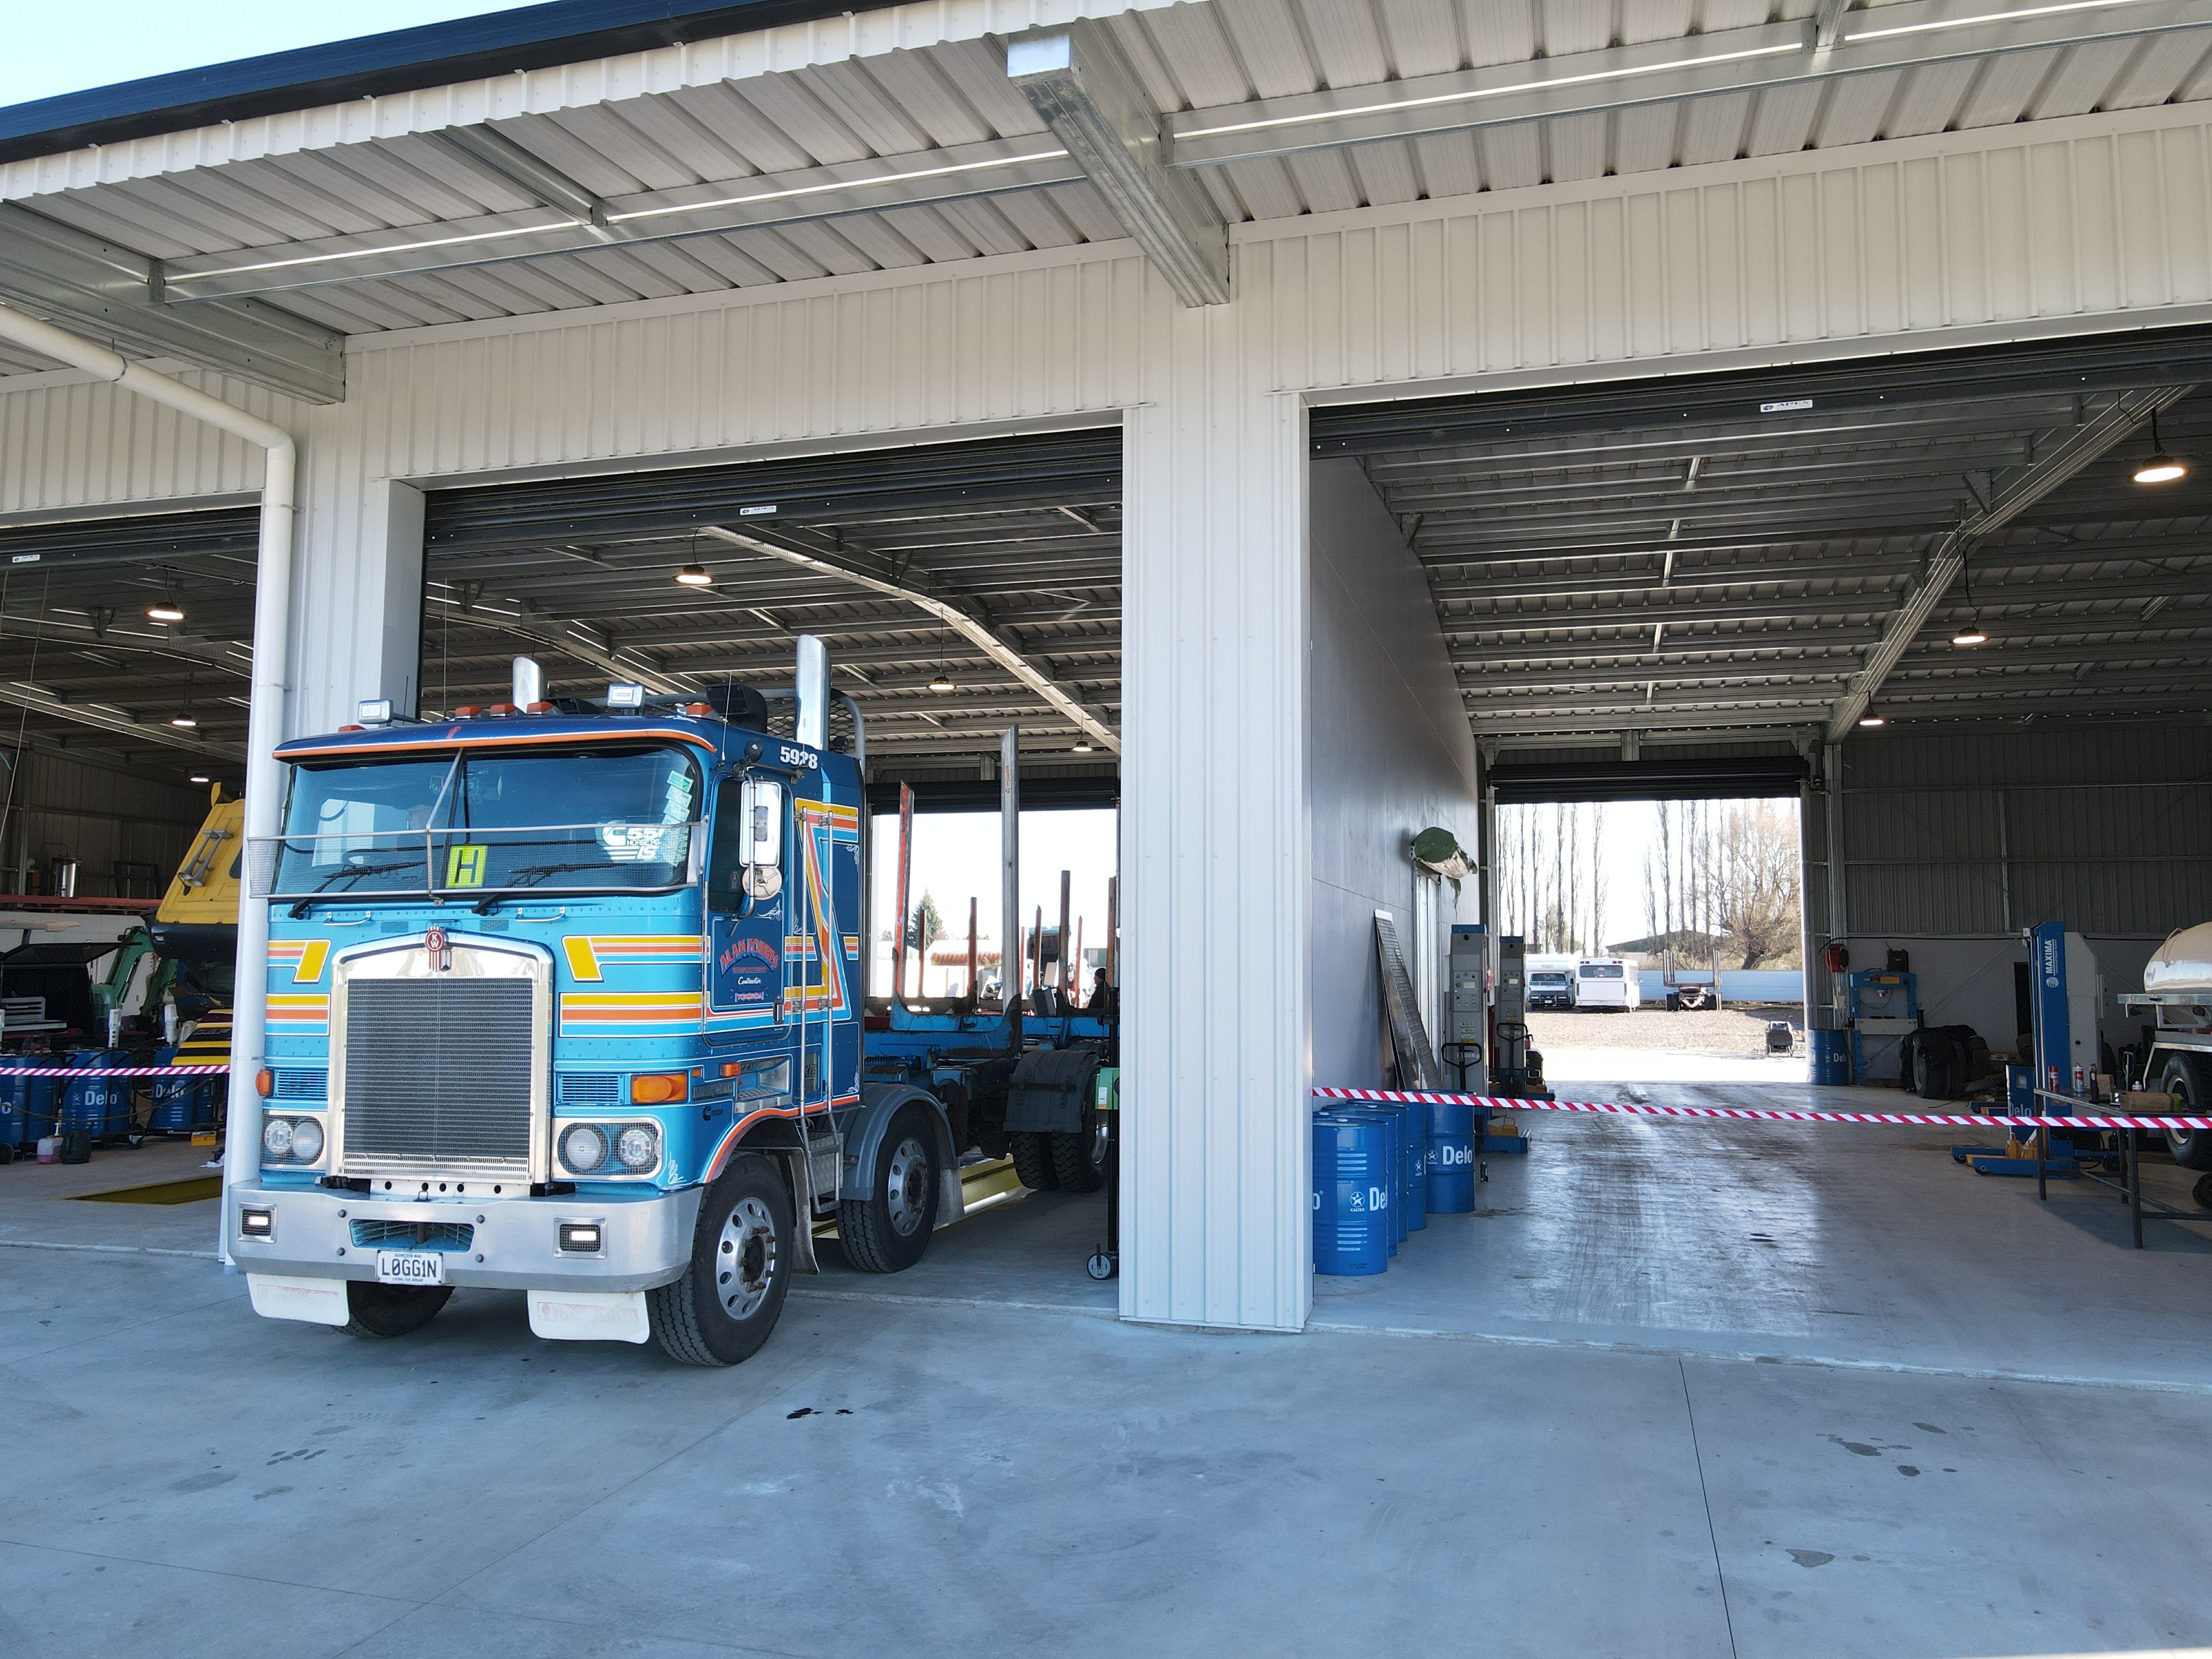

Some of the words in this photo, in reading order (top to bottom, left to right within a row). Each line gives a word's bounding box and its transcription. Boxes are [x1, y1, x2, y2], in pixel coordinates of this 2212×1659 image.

[780, 746, 817, 769] 5928
[455, 849, 479, 883] H
[719, 938, 747, 974] ALAN
[747, 938, 779, 971] FORBES
[2044, 940, 2053, 973] MAXIMA
[738, 977, 761, 985] Contractor
[85, 1090, 117, 1105] Delo
[1442, 1145, 1473, 1165] Delo
